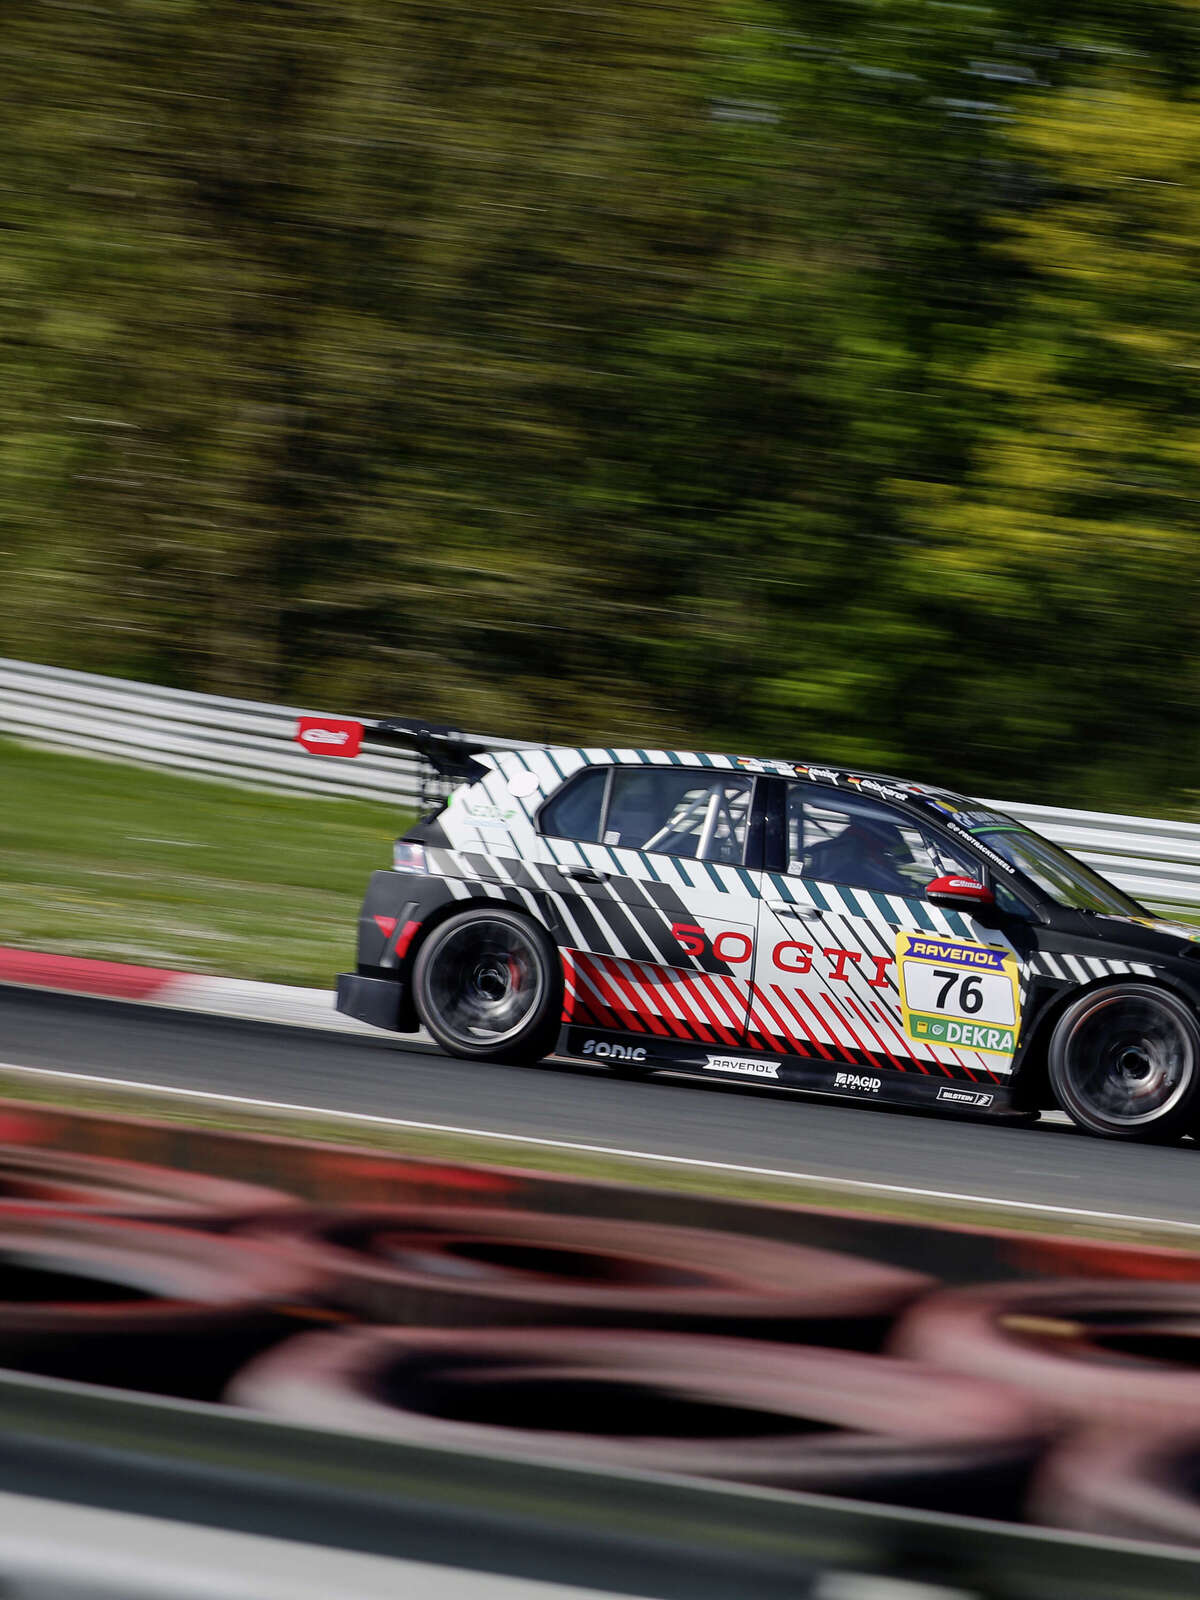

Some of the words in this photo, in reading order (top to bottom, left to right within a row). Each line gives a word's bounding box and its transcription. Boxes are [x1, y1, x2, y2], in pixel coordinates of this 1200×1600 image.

[671, 922, 753, 964] 50
[772, 940, 893, 988] GTI
[913, 942, 999, 966] RAVENOL
[932, 969, 984, 1014] 76
[946, 1022, 1013, 1050] DEKRA
[713, 1059, 773, 1074] RAVENOL
[846, 1073, 882, 1089] PAGID
[942, 1091, 974, 1102] BILSTEIN
